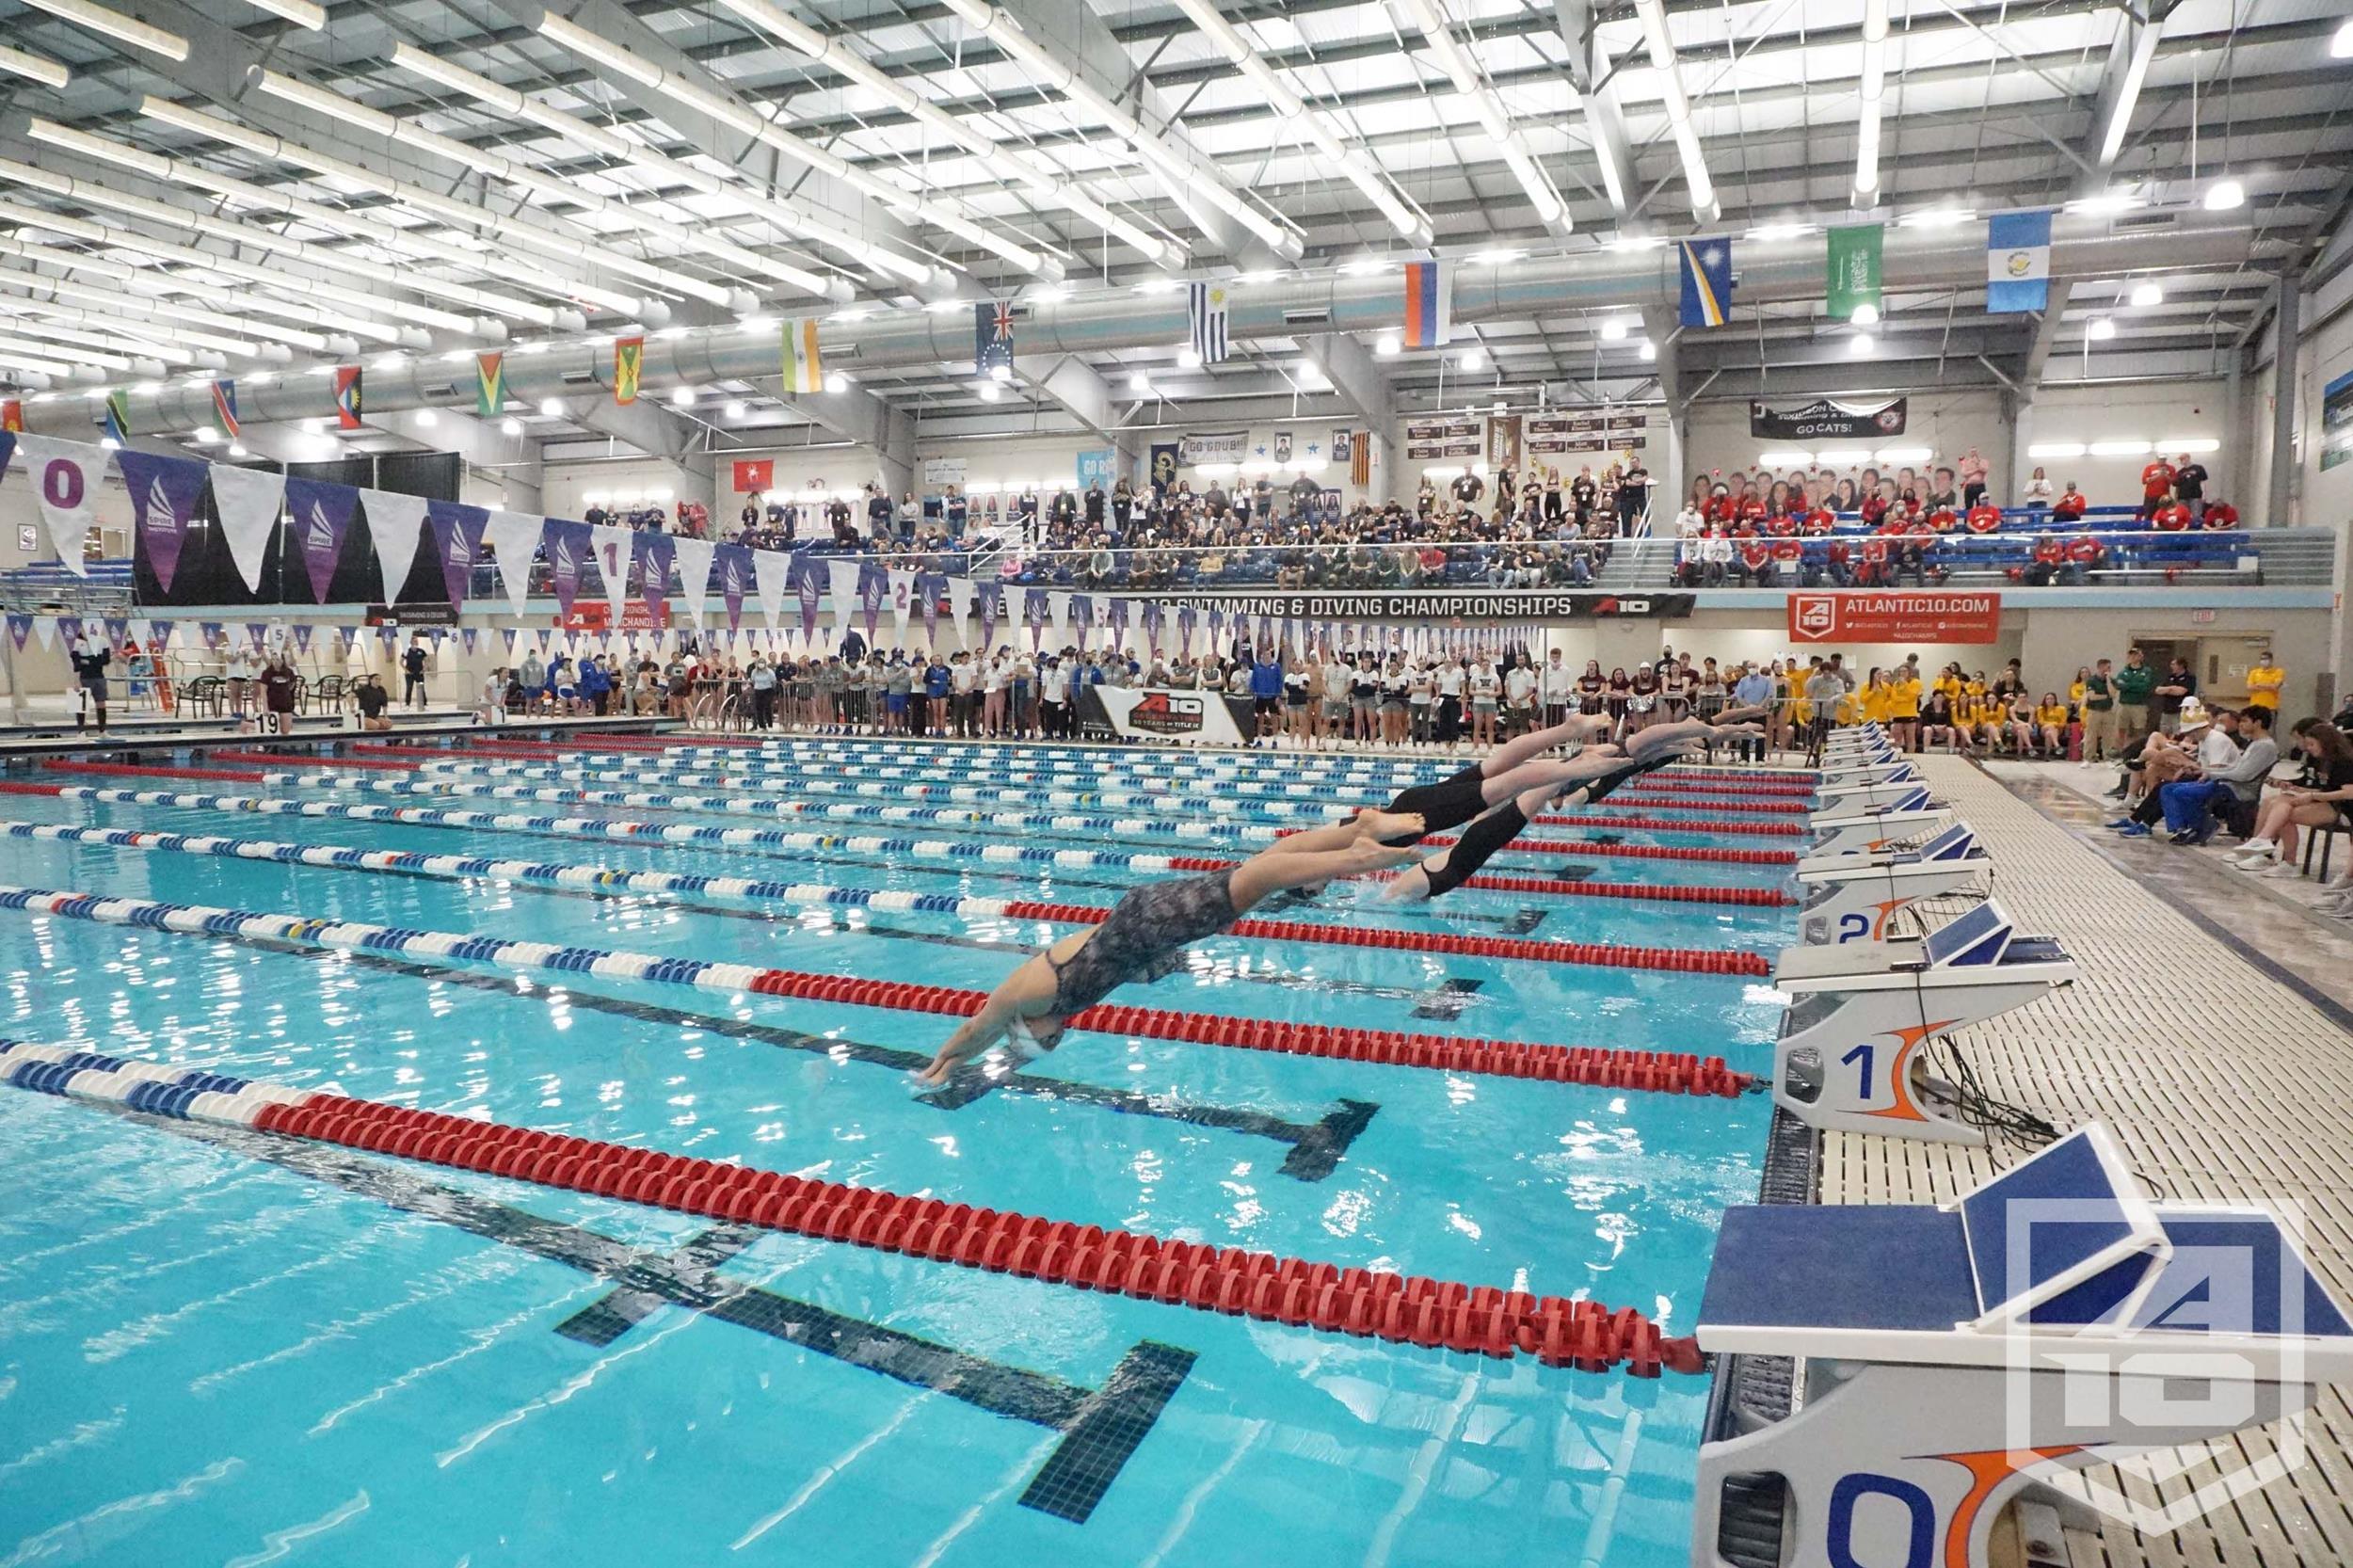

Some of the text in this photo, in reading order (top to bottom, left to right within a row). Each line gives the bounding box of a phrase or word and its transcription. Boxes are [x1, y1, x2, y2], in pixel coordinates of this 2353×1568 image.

[1796, 424, 1852, 435] GO CATS!
[43, 458, 84, 509] 0
[148, 516, 175, 526] SPIRE
[603, 543, 617, 576] 1
[895, 582, 907, 609] 2
[1176, 598, 1286, 615] SWIMMING
[1290, 598, 1305, 615] &
[1311, 598, 1383, 616] DIVING
[1388, 597, 1572, 616] CHAMPIONSHIPS
[1845, 599, 1990, 613] ATLANTIC10.COM
[603, 616, 667, 628] MCHANDIE
[275, 629, 283, 641] 5
[451, 632, 457, 643] 6
[255, 713, 279, 734] 19
[1839, 913, 1869, 944] 2
[1841, 1044, 1875, 1099] 1
[1827, 1472, 1936, 1568] 0
